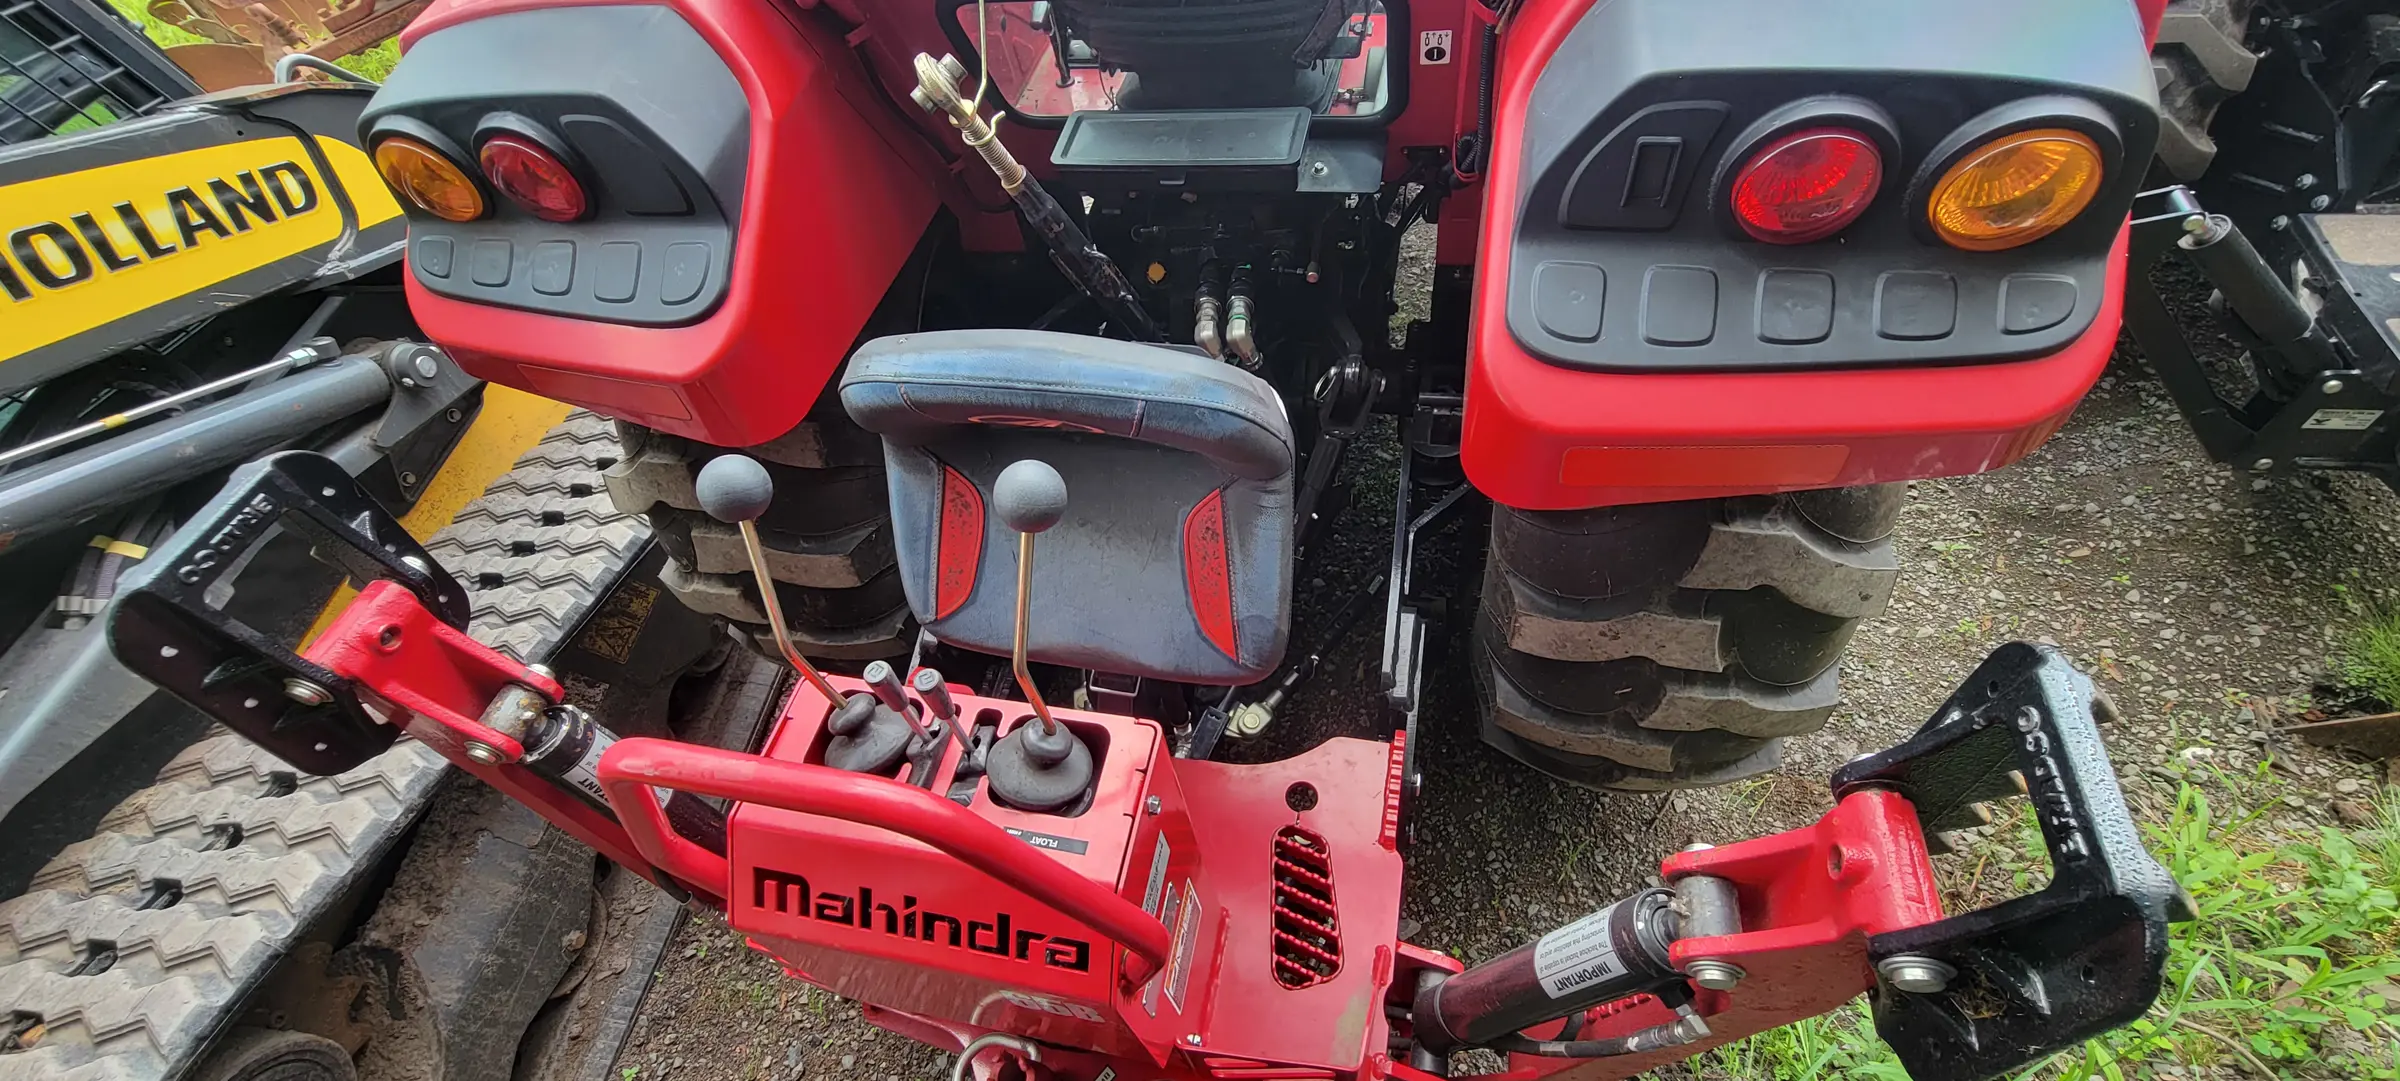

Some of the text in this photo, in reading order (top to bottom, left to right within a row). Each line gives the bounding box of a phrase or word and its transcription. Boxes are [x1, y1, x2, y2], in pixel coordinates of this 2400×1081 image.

[1030, 836, 1059, 848] FLOAT
[753, 866, 1089, 973] Mahindra
[1553, 961, 1612, 991] IMPORTANT
